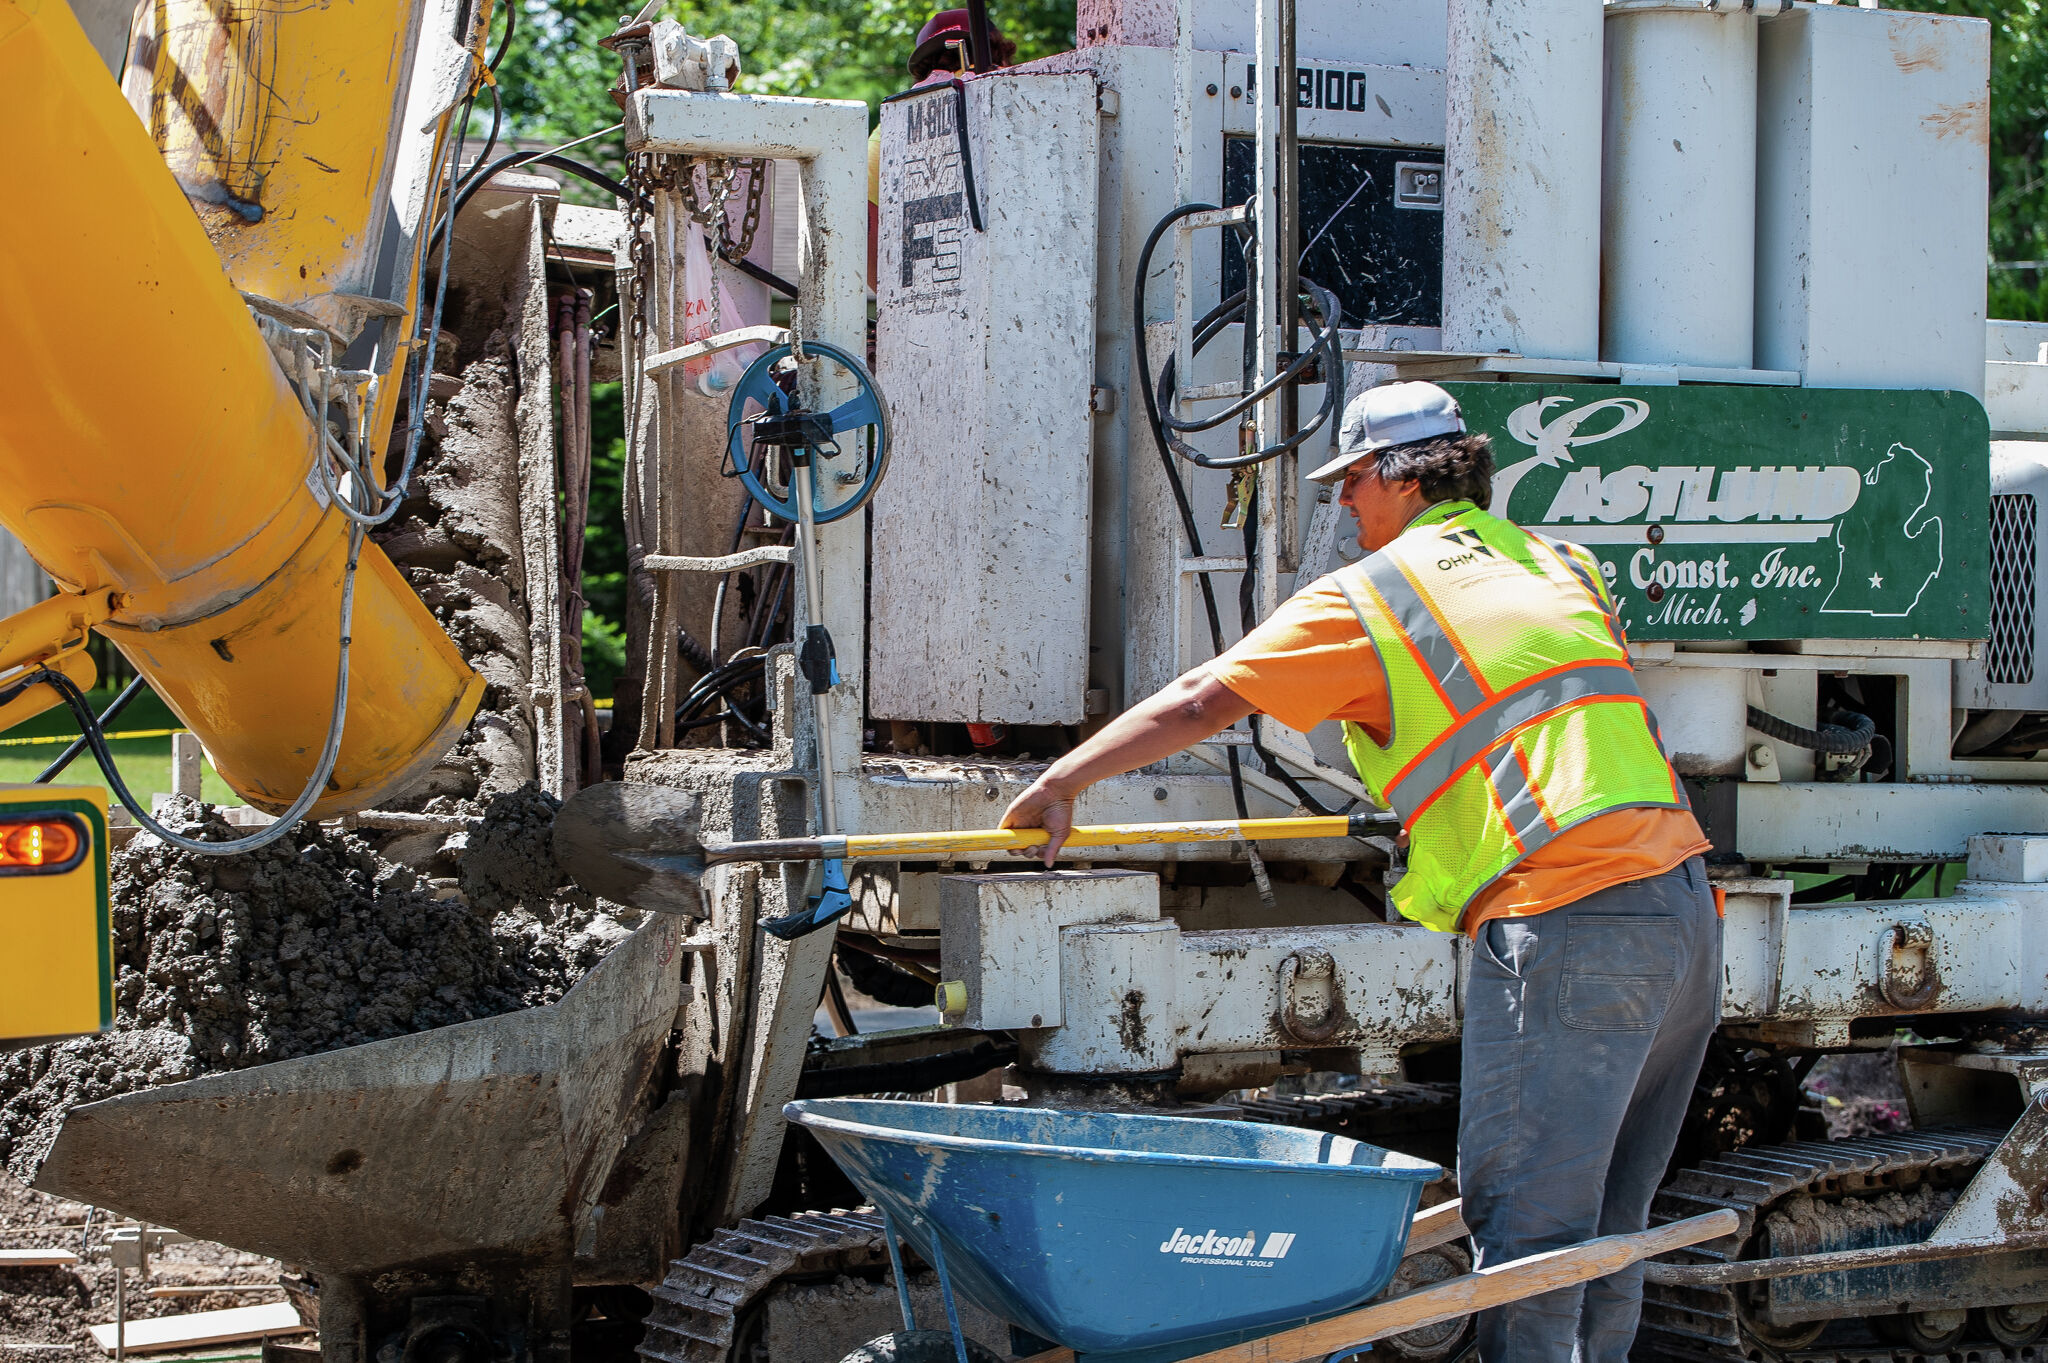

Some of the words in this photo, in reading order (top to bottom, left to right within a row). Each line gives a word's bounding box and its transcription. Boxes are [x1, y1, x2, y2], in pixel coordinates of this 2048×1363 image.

[1437, 553, 1479, 571] OHM
[1629, 547, 1739, 590] Const.
[1751, 547, 1822, 589] Inc.
[1646, 593, 1729, 625] Mich.
[1181, 1256, 1244, 1266] PROFESSIONAL
[1246, 1260, 1275, 1268] TOOLS
